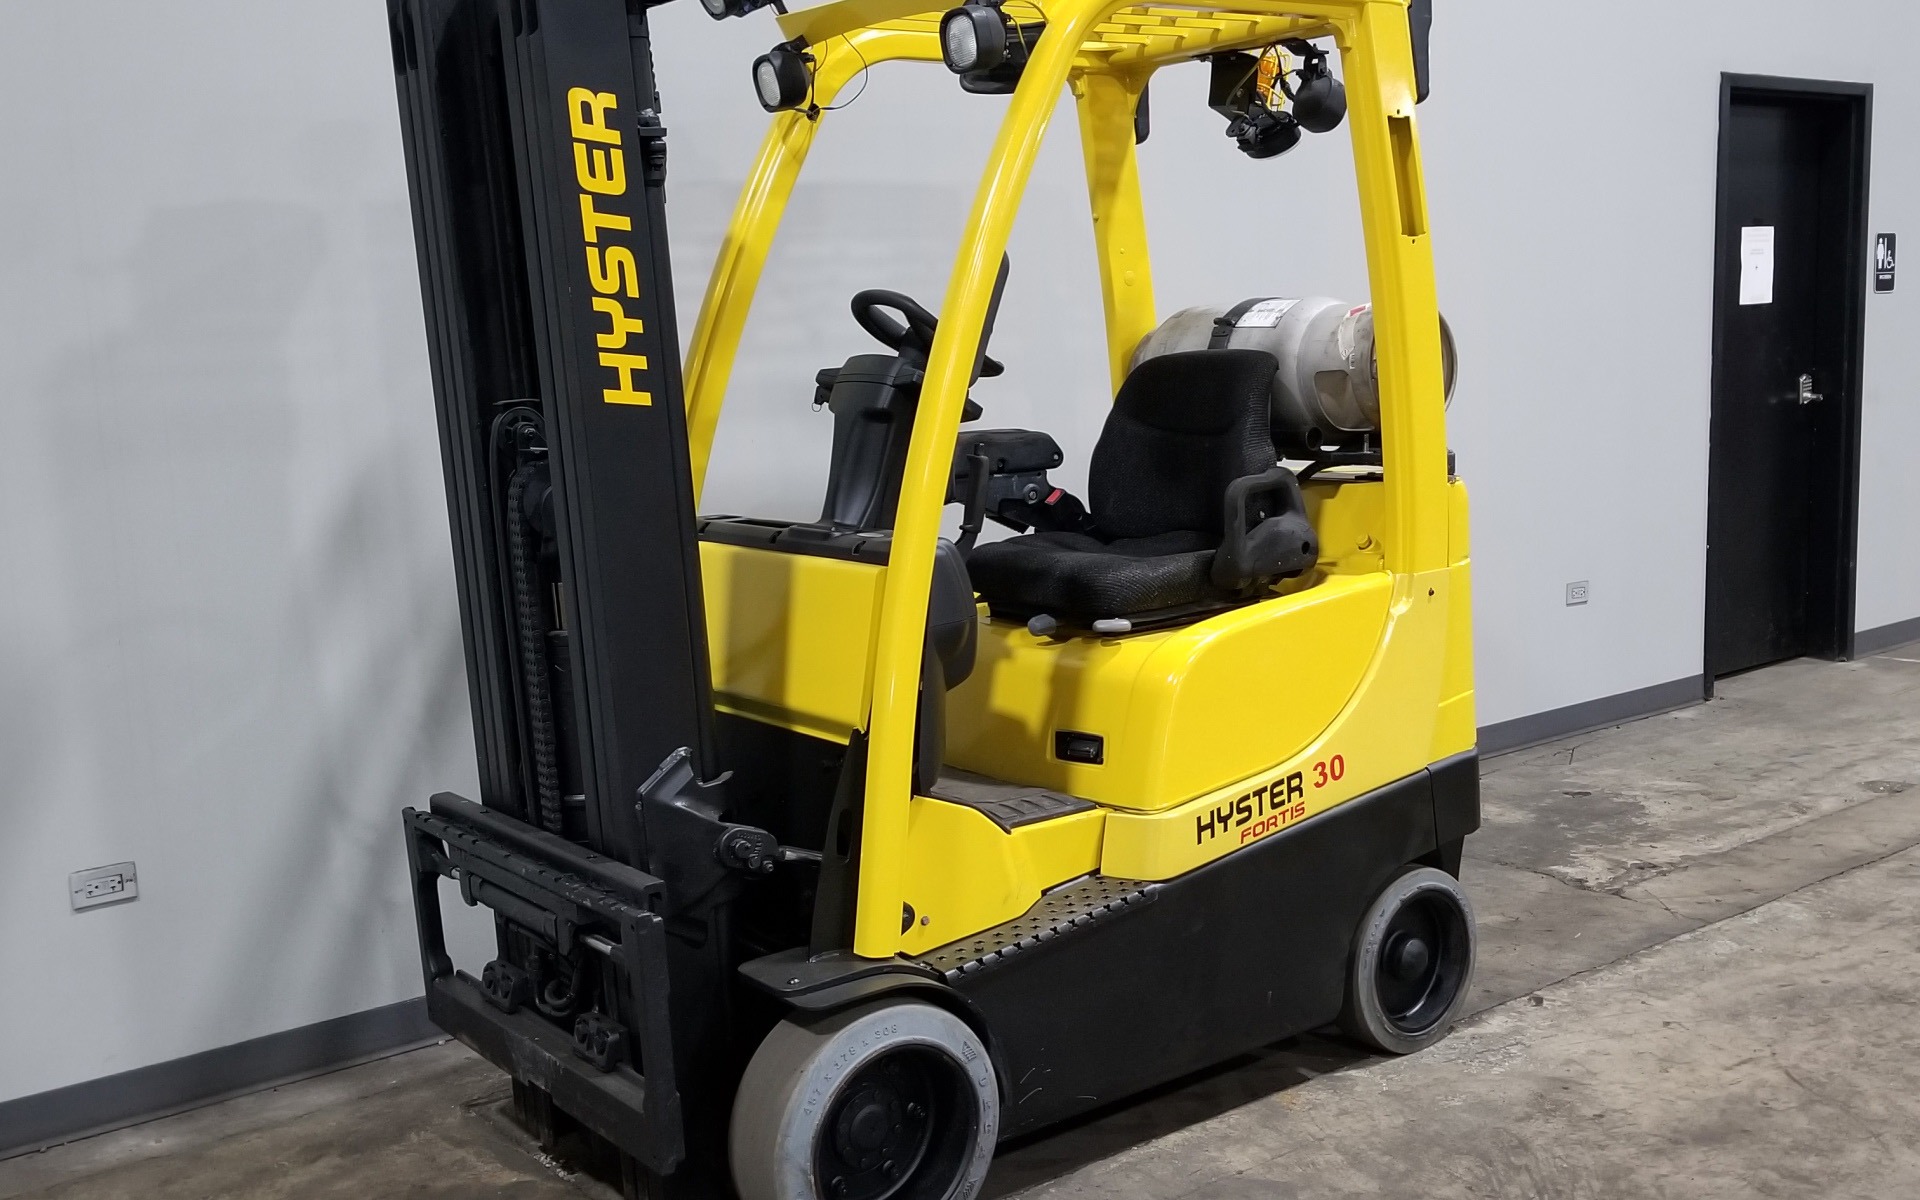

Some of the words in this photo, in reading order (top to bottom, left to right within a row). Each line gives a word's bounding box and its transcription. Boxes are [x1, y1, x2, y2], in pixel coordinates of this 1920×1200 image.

[567, 87, 652, 407] HYSTER
[1196, 771, 1304, 845] HYSTER
[1313, 754, 1345, 789] 30
[1240, 801, 1306, 844] FORTIS
